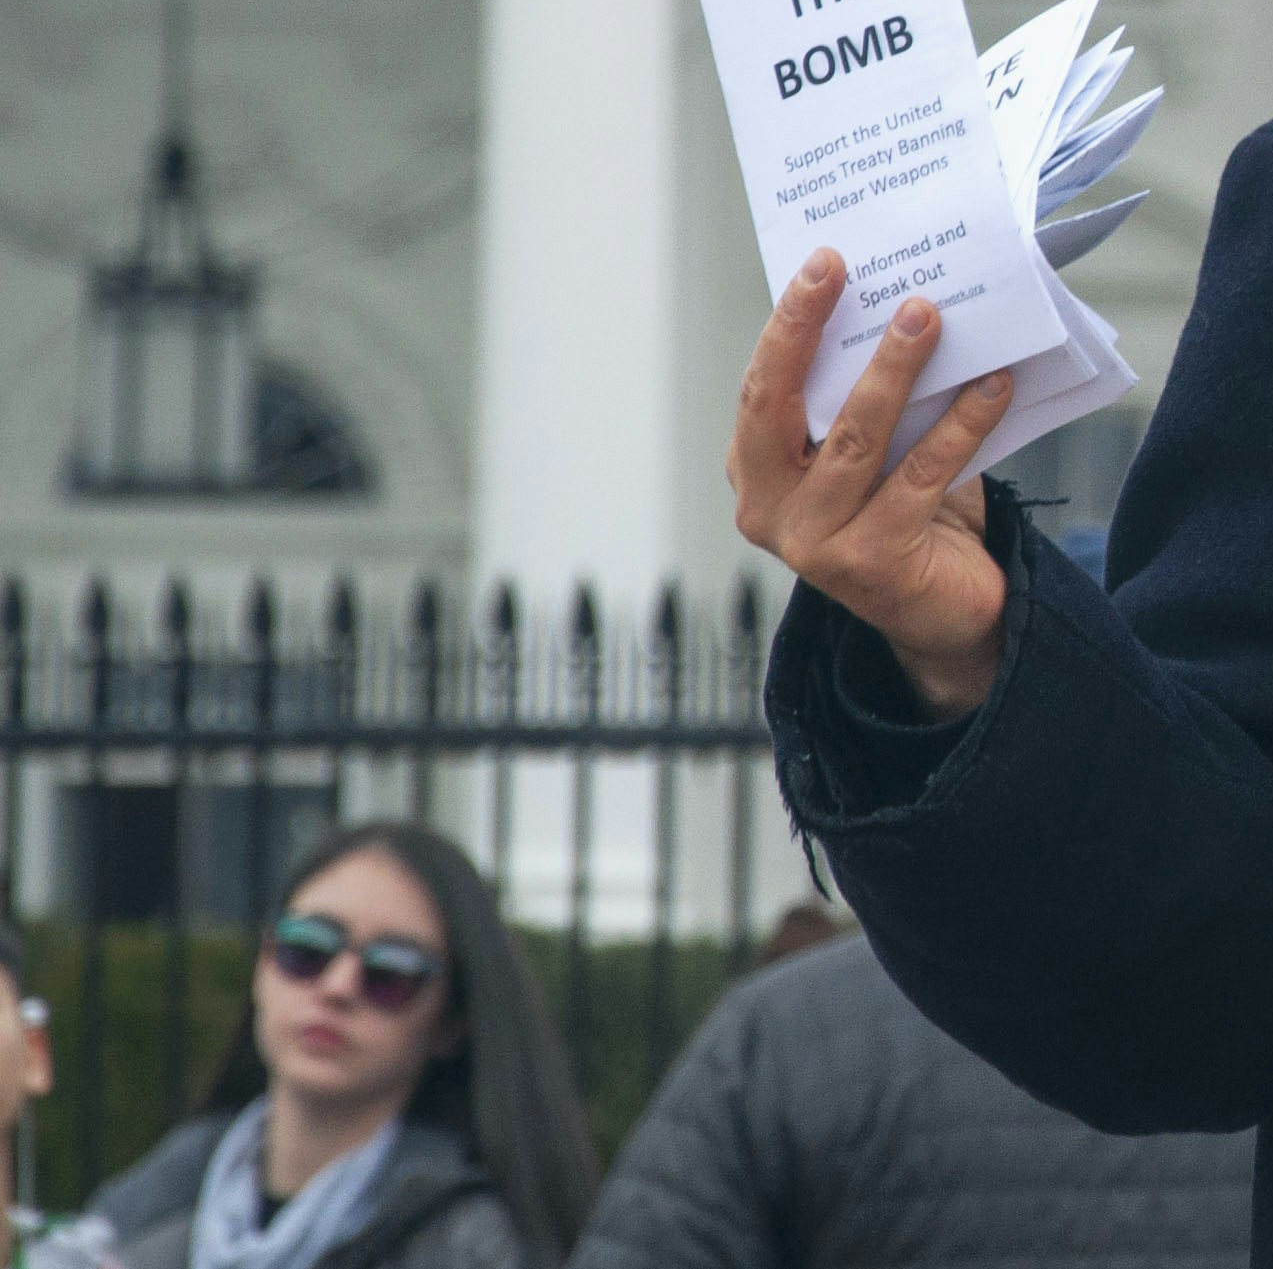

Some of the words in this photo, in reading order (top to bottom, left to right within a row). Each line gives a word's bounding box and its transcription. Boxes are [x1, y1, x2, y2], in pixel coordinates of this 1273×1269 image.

[773, 15, 914, 100] BOMB
[775, 170, 837, 208] Nations
[839, 146, 894, 180] Treaty
[897, 117, 967, 157] Banning
[783, 135, 850, 174] Support
[852, 122, 882, 145] the
[884, 94, 943, 131] United
[803, 187, 866, 225] Nuclear
[868, 155, 950, 197] Weapons
[855, 233, 932, 281] Informed
[935, 219, 967, 247] and
[859, 275, 911, 309] Speak
[912, 261, 946, 287] Out
